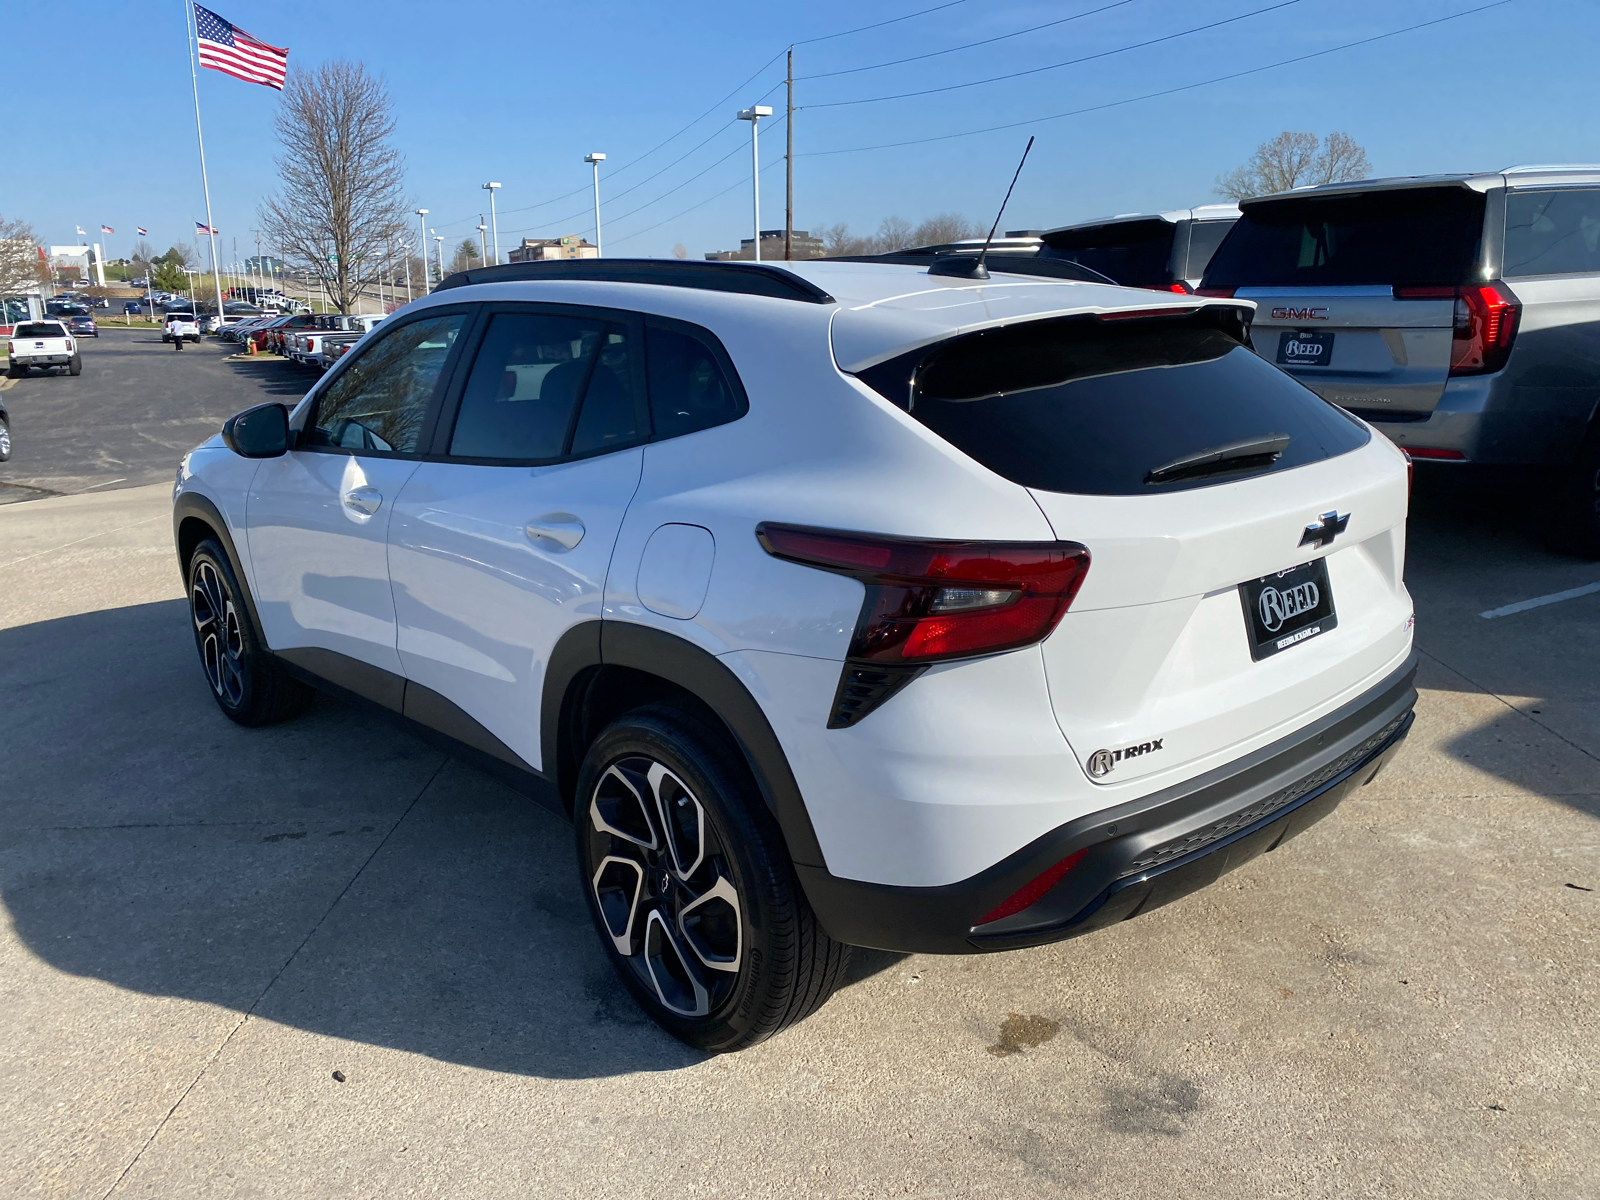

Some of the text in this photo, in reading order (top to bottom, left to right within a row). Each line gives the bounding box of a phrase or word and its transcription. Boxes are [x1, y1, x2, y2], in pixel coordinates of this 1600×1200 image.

[1271, 307, 1330, 320] GMC
[1285, 340, 1323, 357] REED
[1259, 581, 1320, 632] REED
[1112, 737, 1164, 762] TRAX
[741, 947, 763, 1015] Continental
